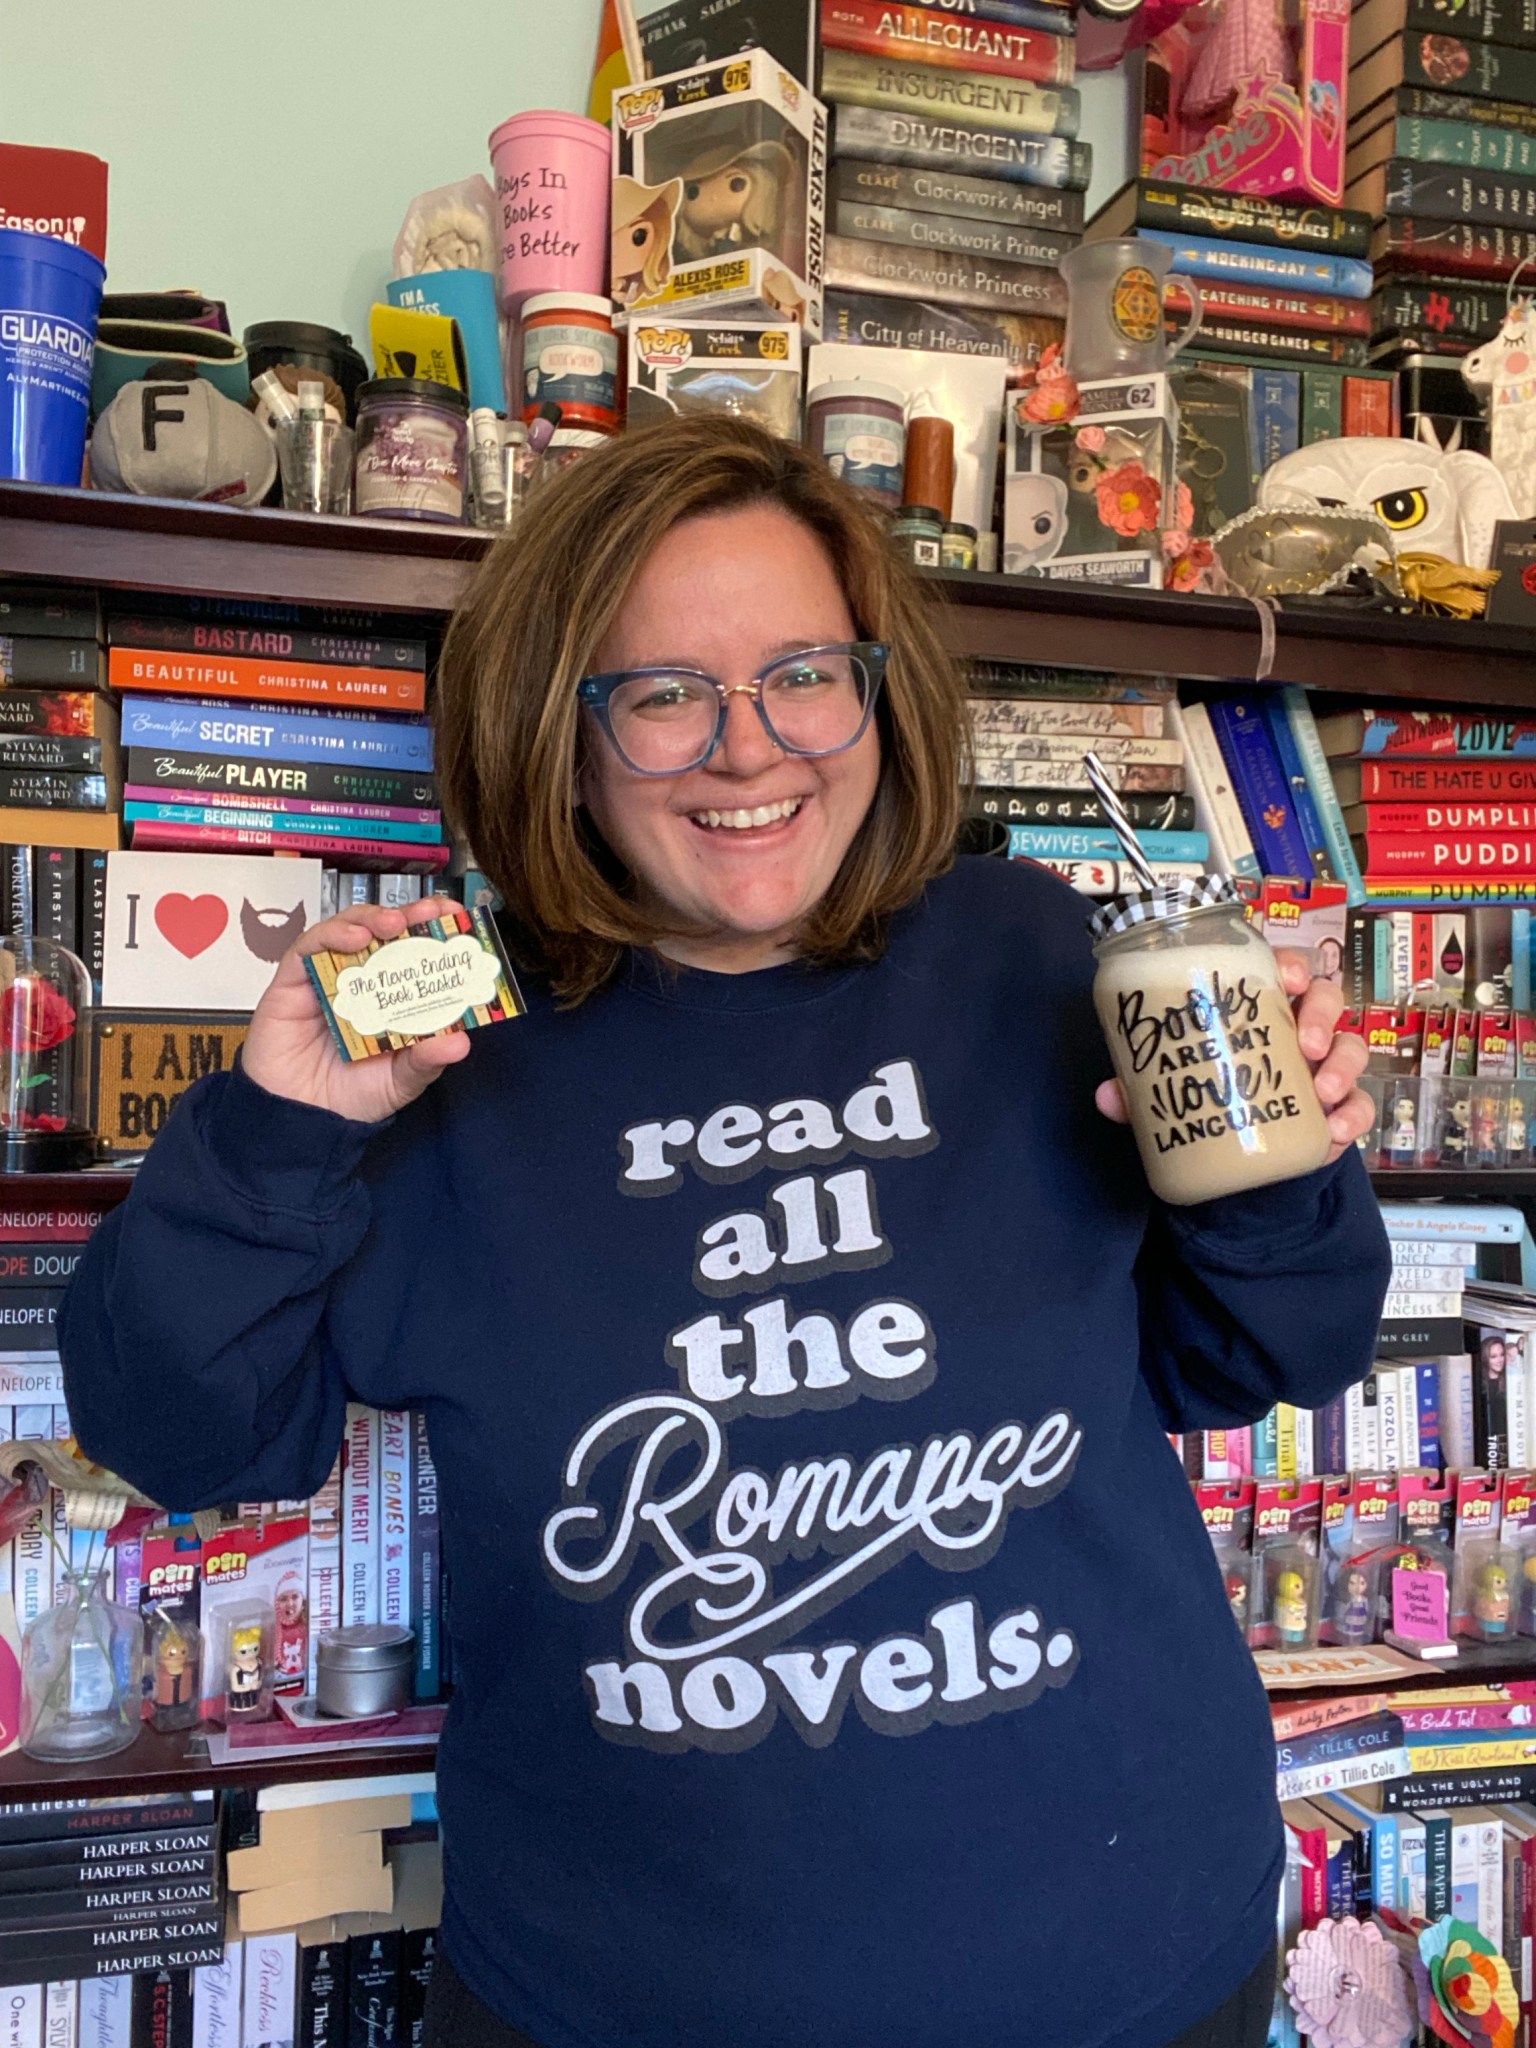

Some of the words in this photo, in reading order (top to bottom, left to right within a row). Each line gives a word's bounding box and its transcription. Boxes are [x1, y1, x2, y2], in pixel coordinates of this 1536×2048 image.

[832, 11, 864, 23] ROTH
[876, 12, 1031, 61] ALLEGIANT
[725, 67, 748, 87] 976
[876, 68, 1031, 114] INSURGENT
[889, 119, 1046, 165] DIVERGENT
[1409, 119, 1422, 159] MAAS
[1471, 129, 1482, 165] COURT
[1504, 134, 1514, 169] WINGS
[809, 108, 825, 211] ALEXIS
[538, 168, 567, 189] In
[914, 178, 1007, 209] Clockwork
[1012, 194, 1062, 220] Angel
[1232, 198, 1283, 216] BALLAD
[1462, 178, 1472, 212] COURT
[1495, 187, 1503, 211] MIST
[1511, 189, 1520, 212] AND
[504, 198, 553, 229] Books
[1181, 204, 1254, 226] SONGBIRDS
[1279, 220, 1329, 238] SNAKES
[520, 230, 580, 257] Better
[808, 216, 822, 293] ROSE
[910, 222, 1001, 252] Clockwork
[1006, 236, 1058, 260] Prince
[673, 268, 712, 289] ALEXIS
[715, 261, 745, 278] ROSE
[863, 255, 969, 288] Clockwork
[974, 271, 1051, 300] Princess
[1206, 251, 1307, 276] MOCKINGJAY
[1200, 289, 1270, 309] CATCHING
[1276, 300, 1308, 314] FIRE
[637, 327, 691, 355] POP!
[762, 337, 787, 353] 975
[860, 320, 902, 349] City
[907, 330, 923, 349] of
[930, 330, 1020, 364] Heavenly
[1216, 328, 1268, 345] HUNGER
[1270, 335, 1310, 350] GAMES
[1130, 389, 1150, 405] 62
[141, 384, 189, 452] F
[1050, 564, 1084, 579] DAVOS
[1086, 560, 1145, 577] SEAWORTH
[194, 626, 293, 655] BASTARD
[133, 663, 239, 685] BEAUTIFUL
[259, 675, 328, 690] CHRISTINA
[337, 682, 387, 695] LAUREN
[130, 713, 197, 739] Beautiful
[200, 721, 274, 747] SECRET
[1457, 722, 1516, 751] LOVE
[3, 752, 64, 763] REYNARD
[6, 742, 61, 753] SYLVAIN
[12, 778, 67, 789] SYLVAIN
[154, 757, 225, 783] Beautiful
[226, 763, 308, 792] PLAYER
[334, 775, 400, 790] CHRISTINA
[1388, 771, 1426, 789] THE
[1434, 771, 1479, 789] HATE
[1489, 771, 1501, 789] U
[10, 788, 70, 800] REYNARD
[212, 793, 288, 811] BOMBSHELL
[310, 803, 354, 815] CHRISTINA
[359, 808, 390, 817] LAUREN
[204, 810, 274, 828] BEGINNING
[1427, 808, 1536, 826] DUMPLI
[238, 831, 271, 844] BITCH
[1386, 851, 1425, 859] MURPHY
[52, 872, 62, 922] FIRST
[93, 878, 103, 921] LAST
[1375, 890, 1412, 898] MURPHY
[125, 893, 140, 949] I
[93, 930, 103, 969] KISS
[1354, 934, 1363, 972] CHEVY
[349, 977, 376, 996] The
[378, 967, 420, 988] Never
[421, 951, 472, 976] Ending
[376, 985, 413, 1010] Book
[415, 970, 464, 998] Basket
[1117, 971, 1261, 1073] Books
[121, 1033, 132, 1080] I
[153, 1033, 222, 1080] AM
[1158, 1038, 1222, 1075] ARE
[1230, 1025, 1272, 1054] MY
[624, 1060, 931, 1181] read
[1154, 1094, 1300, 1153] LANGUAGE
[700, 1169, 883, 1280] all
[672, 1299, 925, 1402] the
[1402, 1333, 1430, 1342] GREY
[1384, 1396, 1394, 1448] KOZOL
[351, 1418, 370, 1489] WITHOUT
[384, 1470, 405, 1535] BONES
[351, 1494, 370, 1544] MERIT
[544, 1396, 1083, 1660] Romance
[150, 1582, 193, 1596] mates
[206, 1568, 246, 1585] mates
[353, 1562, 366, 1611] COLLEEN
[25, 1568, 38, 1617] COLLEEN
[386, 1567, 400, 1621] COLLEEN
[1402, 1614, 1438, 1625] Friends
[585, 1600, 1074, 1732] novels.
[1420, 1709, 1452, 1730] Bride
[1455, 1709, 1476, 1727] Test
[1320, 1738, 1354, 1754] TILLIE
[1358, 1731, 1389, 1746] COLE
[1341, 1768, 1368, 1783] Tillie
[1371, 1762, 1395, 1778] Cole
[1403, 1785, 1425, 1793] ALL
[1431, 1782, 1454, 1791] THE
[1461, 1779, 1491, 1789] UGLY
[1498, 1777, 1521, 1785] AND
[1403, 1795, 1473, 1808] WONDERFUL
[1480, 1791, 1521, 1800] THINGS
[67, 1812, 132, 1830] HARPER
[140, 1808, 194, 1822] SLOAN
[83, 1841, 150, 1859] HARPER
[156, 1835, 209, 1853] SLOAN
[1380, 1832, 1394, 1859] SO
[1434, 1829, 1446, 1862] THE
[80, 1863, 147, 1881] HARPER
[151, 1858, 204, 1875] SLOAN
[1341, 1859, 1351, 1887] THE
[86, 1888, 153, 1908] HARPER
[158, 1885, 211, 1901] SLOAN
[1434, 1865, 1446, 1910] PAPER
[113, 1911, 157, 1922] HARPER
[161, 1907, 196, 1917] SLOAN
[93, 1927, 160, 1946] HARPER
[164, 1921, 218, 1938] SLOAN
[96, 1954, 164, 1974] HARPER
[168, 1948, 221, 1965] SLOAN
[11, 1996, 25, 2027] One
[314, 2003, 329, 2035] This
